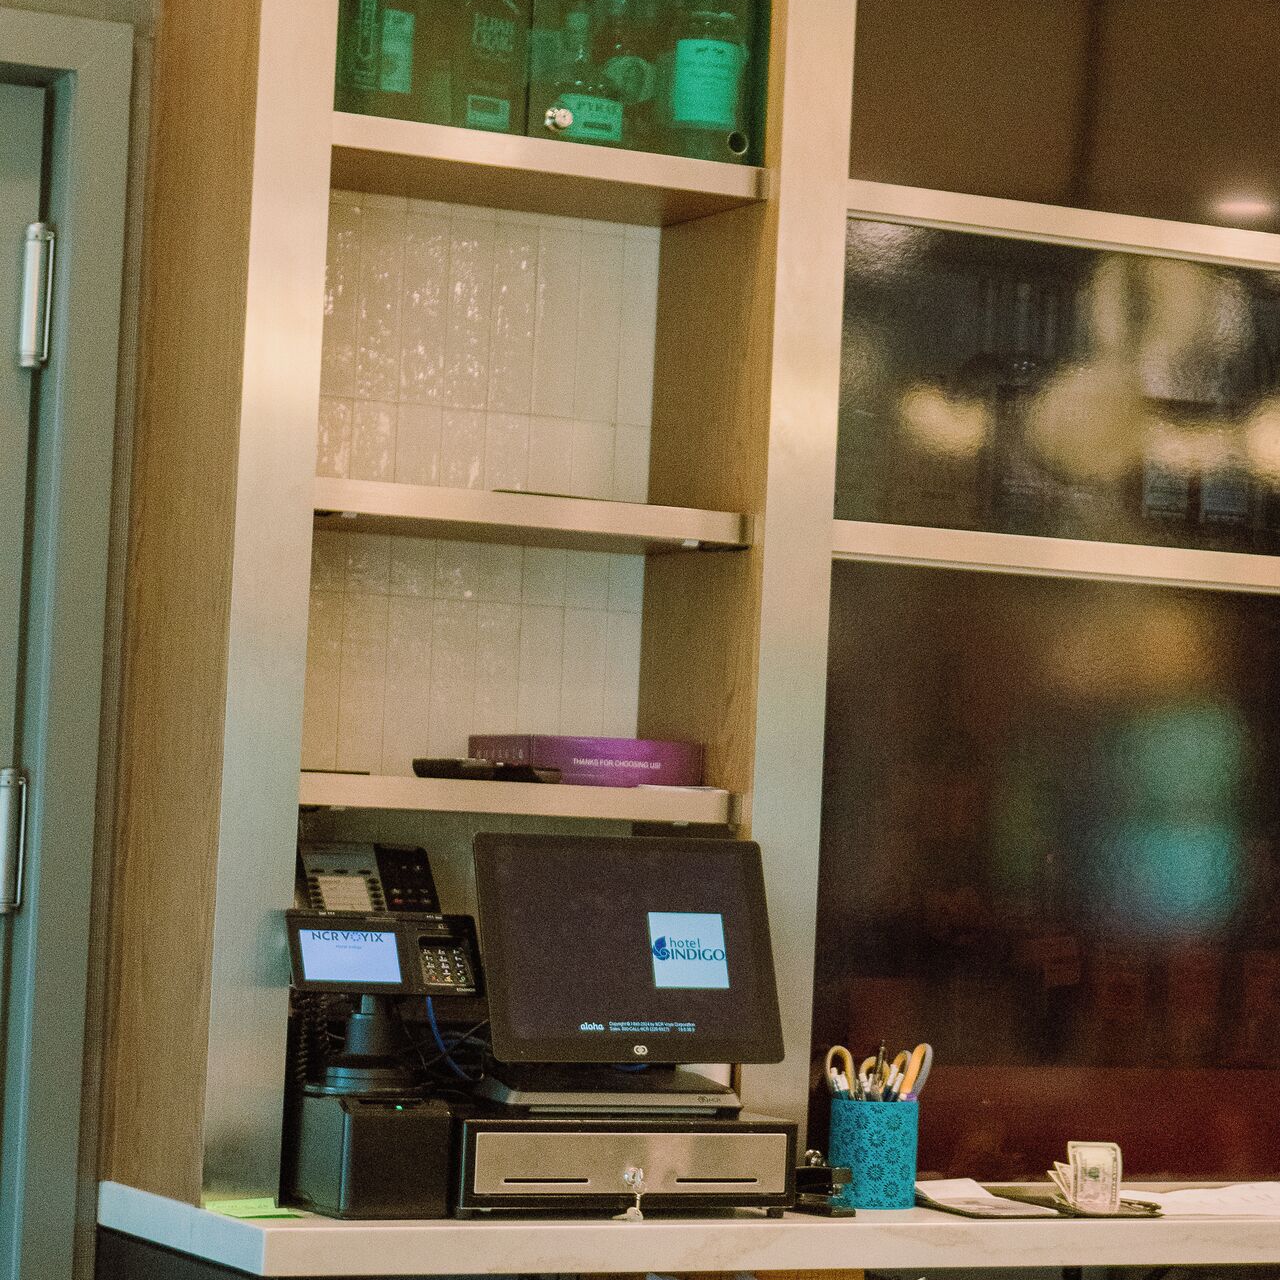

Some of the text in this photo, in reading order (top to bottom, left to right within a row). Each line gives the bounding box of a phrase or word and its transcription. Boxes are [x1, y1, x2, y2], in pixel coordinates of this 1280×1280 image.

[573, 757, 599, 766] THANKS
[600, 759, 614, 767] FOR
[614, 760, 649, 769] CHOOSING
[311, 931, 383, 942] NCR VOYIX
[669, 937, 700, 948] hotel
[671, 949, 725, 960] INDIGO
[580, 1022, 604, 1031] aloha
